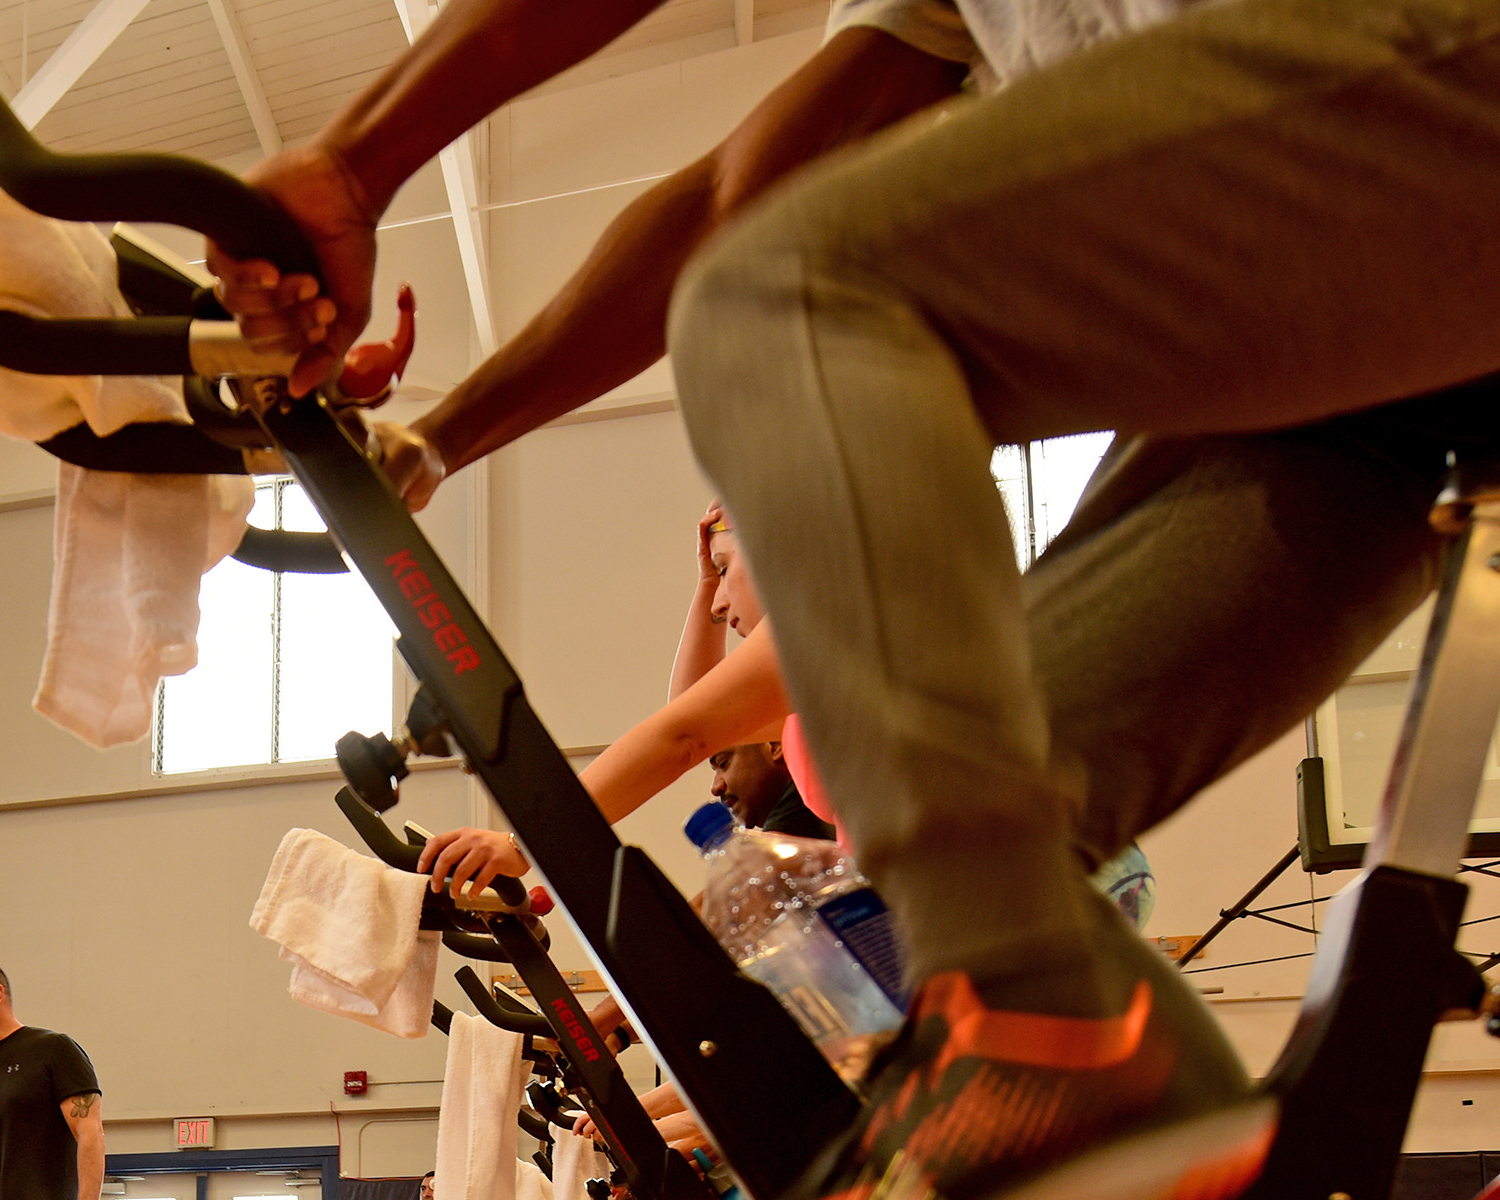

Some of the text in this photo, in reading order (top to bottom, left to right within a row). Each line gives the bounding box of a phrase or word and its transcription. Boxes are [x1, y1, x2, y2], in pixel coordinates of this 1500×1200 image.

[384, 548, 481, 676] KEISER
[551, 997, 600, 1063] KEISER
[178, 1121, 210, 1145] EXIT
